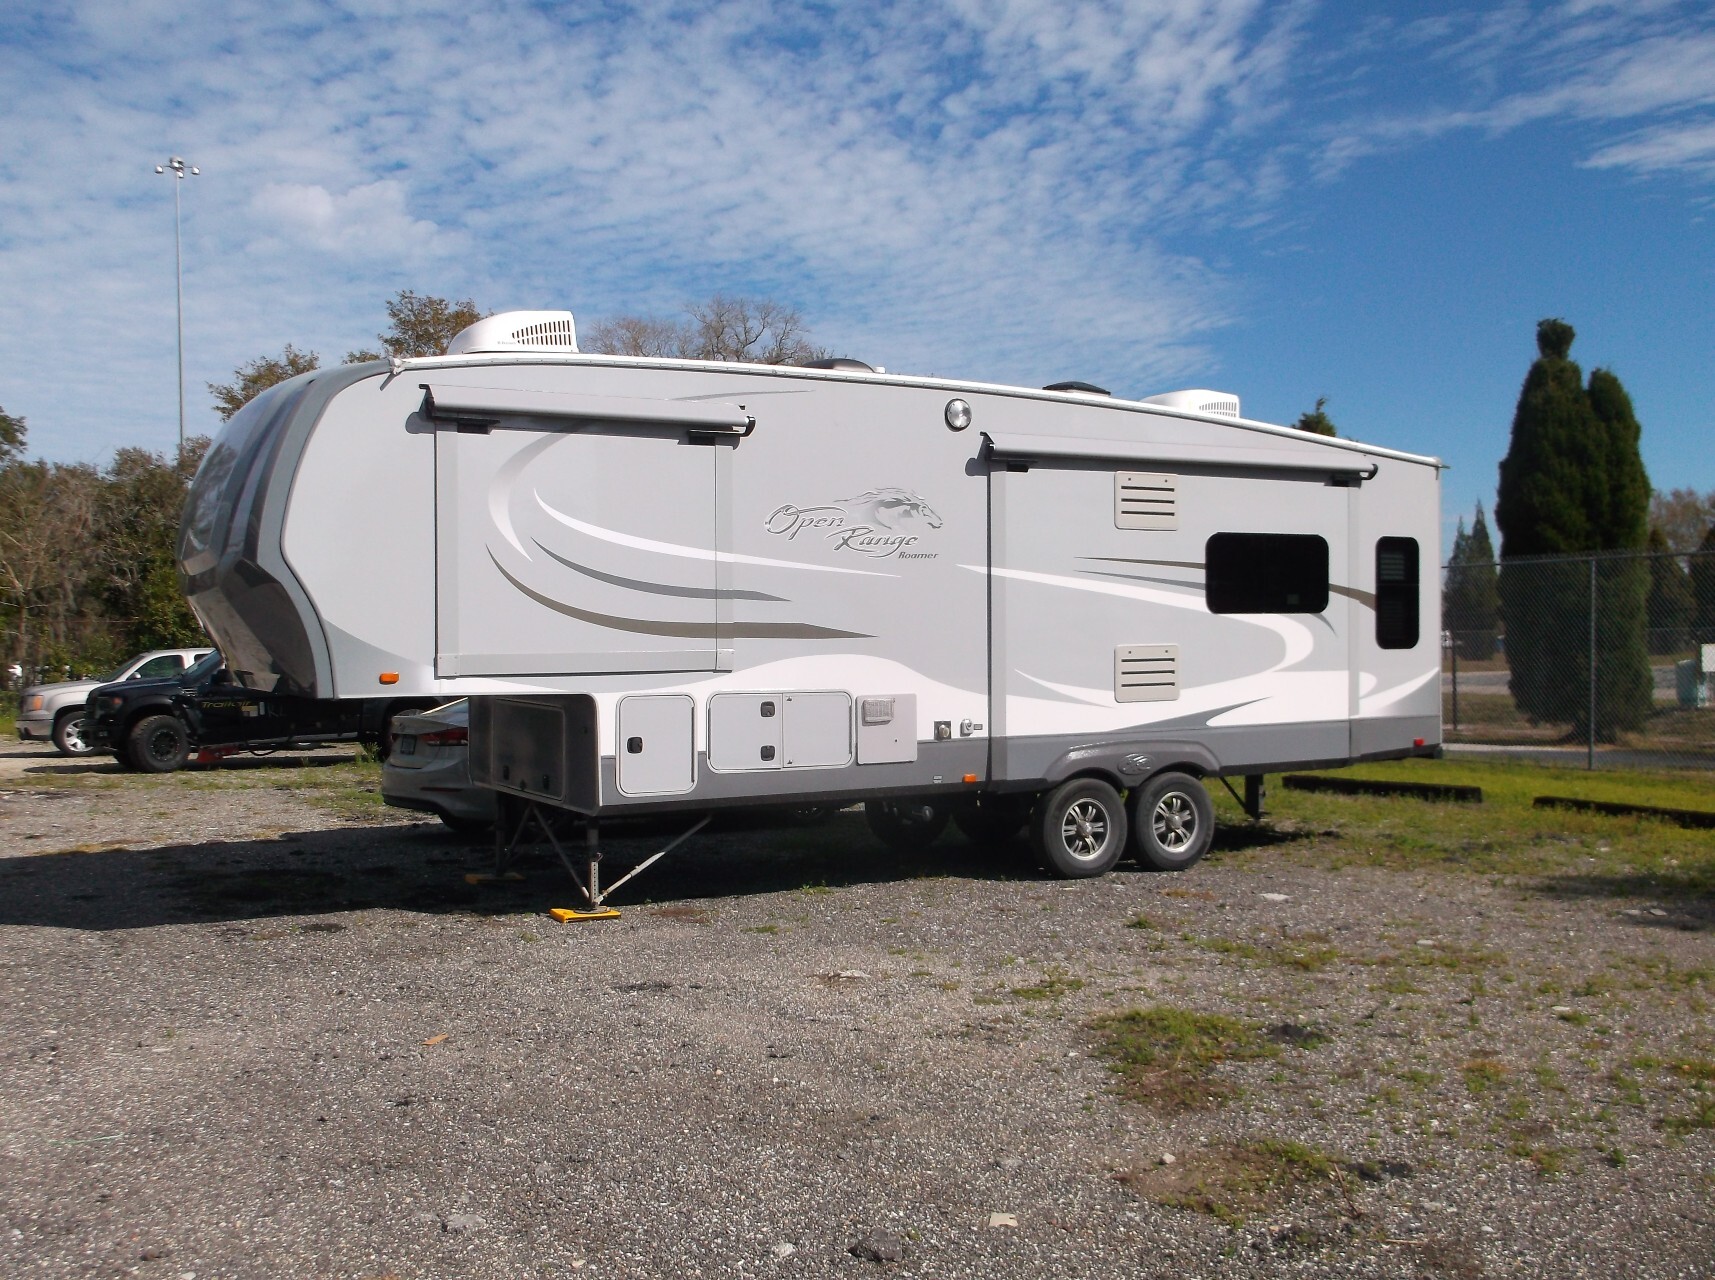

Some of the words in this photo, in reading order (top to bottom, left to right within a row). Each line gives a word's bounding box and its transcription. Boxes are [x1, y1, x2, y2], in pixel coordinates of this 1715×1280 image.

[765, 504, 848, 541] Open
[825, 525, 919, 558] Range
[898, 551, 939, 559] Roamer
